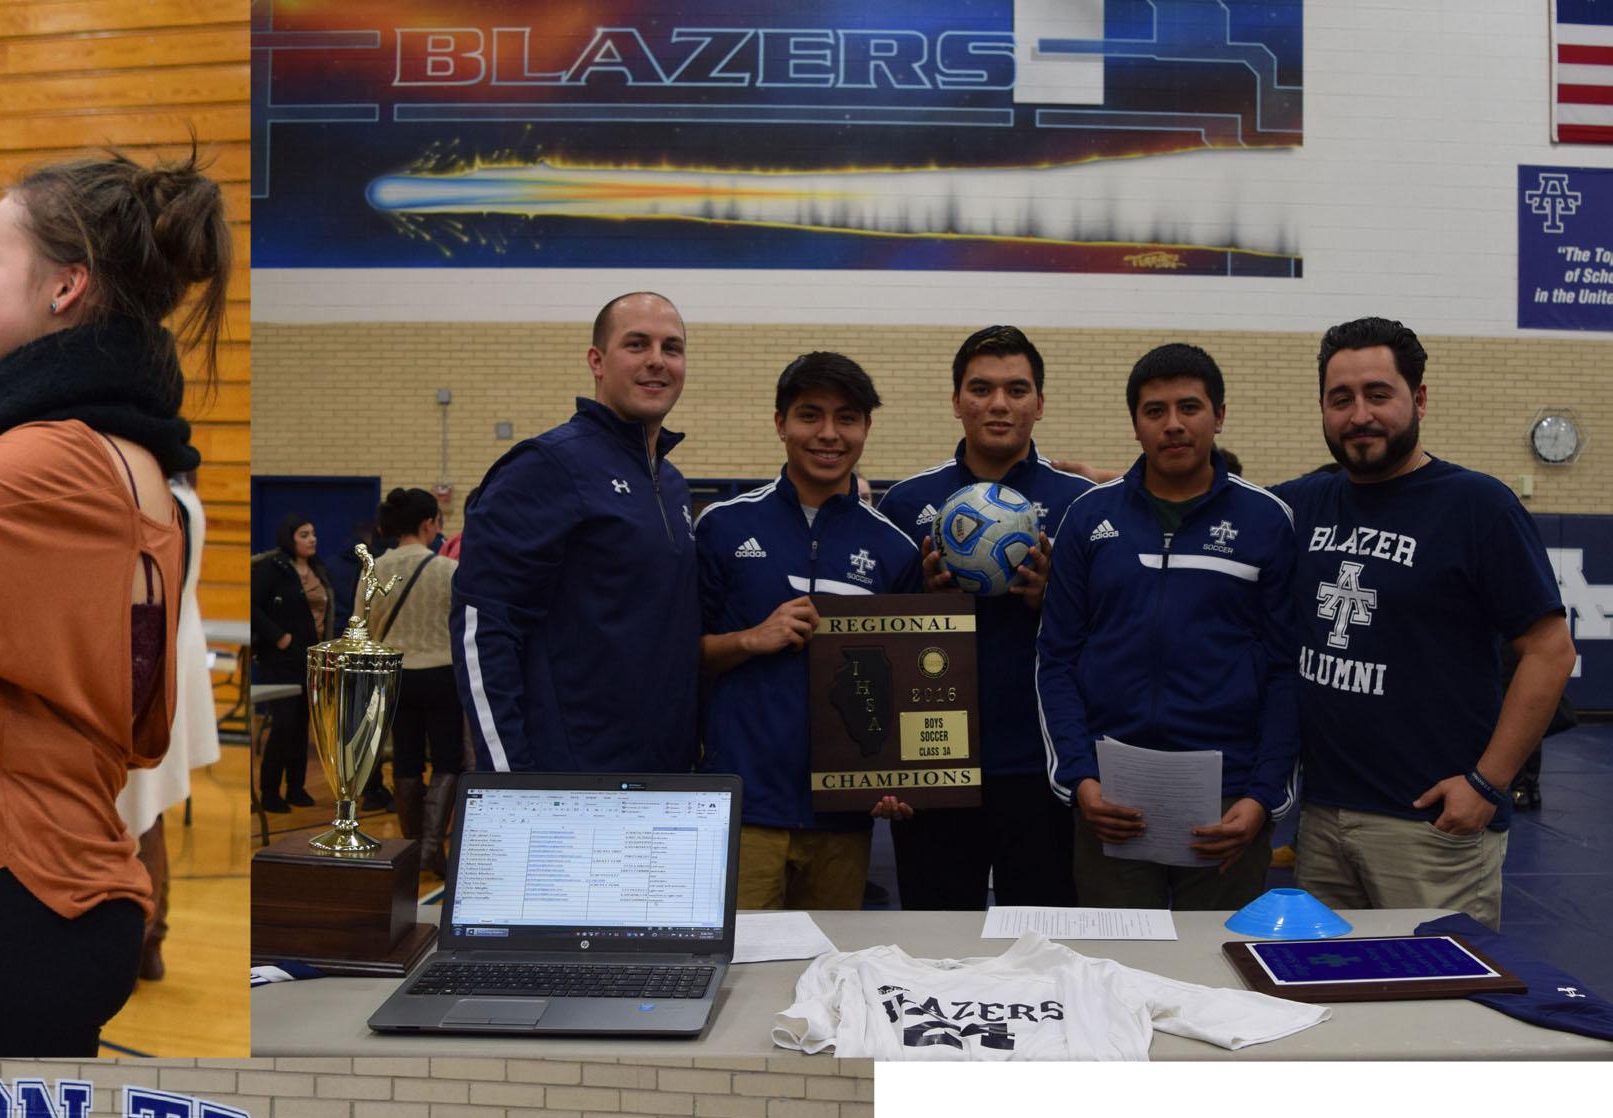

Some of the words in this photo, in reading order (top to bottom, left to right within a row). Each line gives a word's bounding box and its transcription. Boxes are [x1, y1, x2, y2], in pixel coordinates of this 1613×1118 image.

[392, 28, 1019, 89] BLAZERS
[1565, 268, 1580, 283] of
[1535, 288, 1549, 303] in
[1553, 288, 1575, 304] the
[1203, 543, 1234, 554] SOCCER
[1308, 525, 1417, 568] BLAZER
[846, 572, 874, 585] SOCCER
[829, 617, 957, 633] REGIONAL
[1299, 645, 1387, 696] ALUMNI
[911, 687, 957, 703] 2016
[924, 717, 944, 729] BOYS
[920, 730, 949, 743] SOCCER
[919, 746, 940, 757] CLASS
[821, 770, 971, 789] CHAMPIONS
